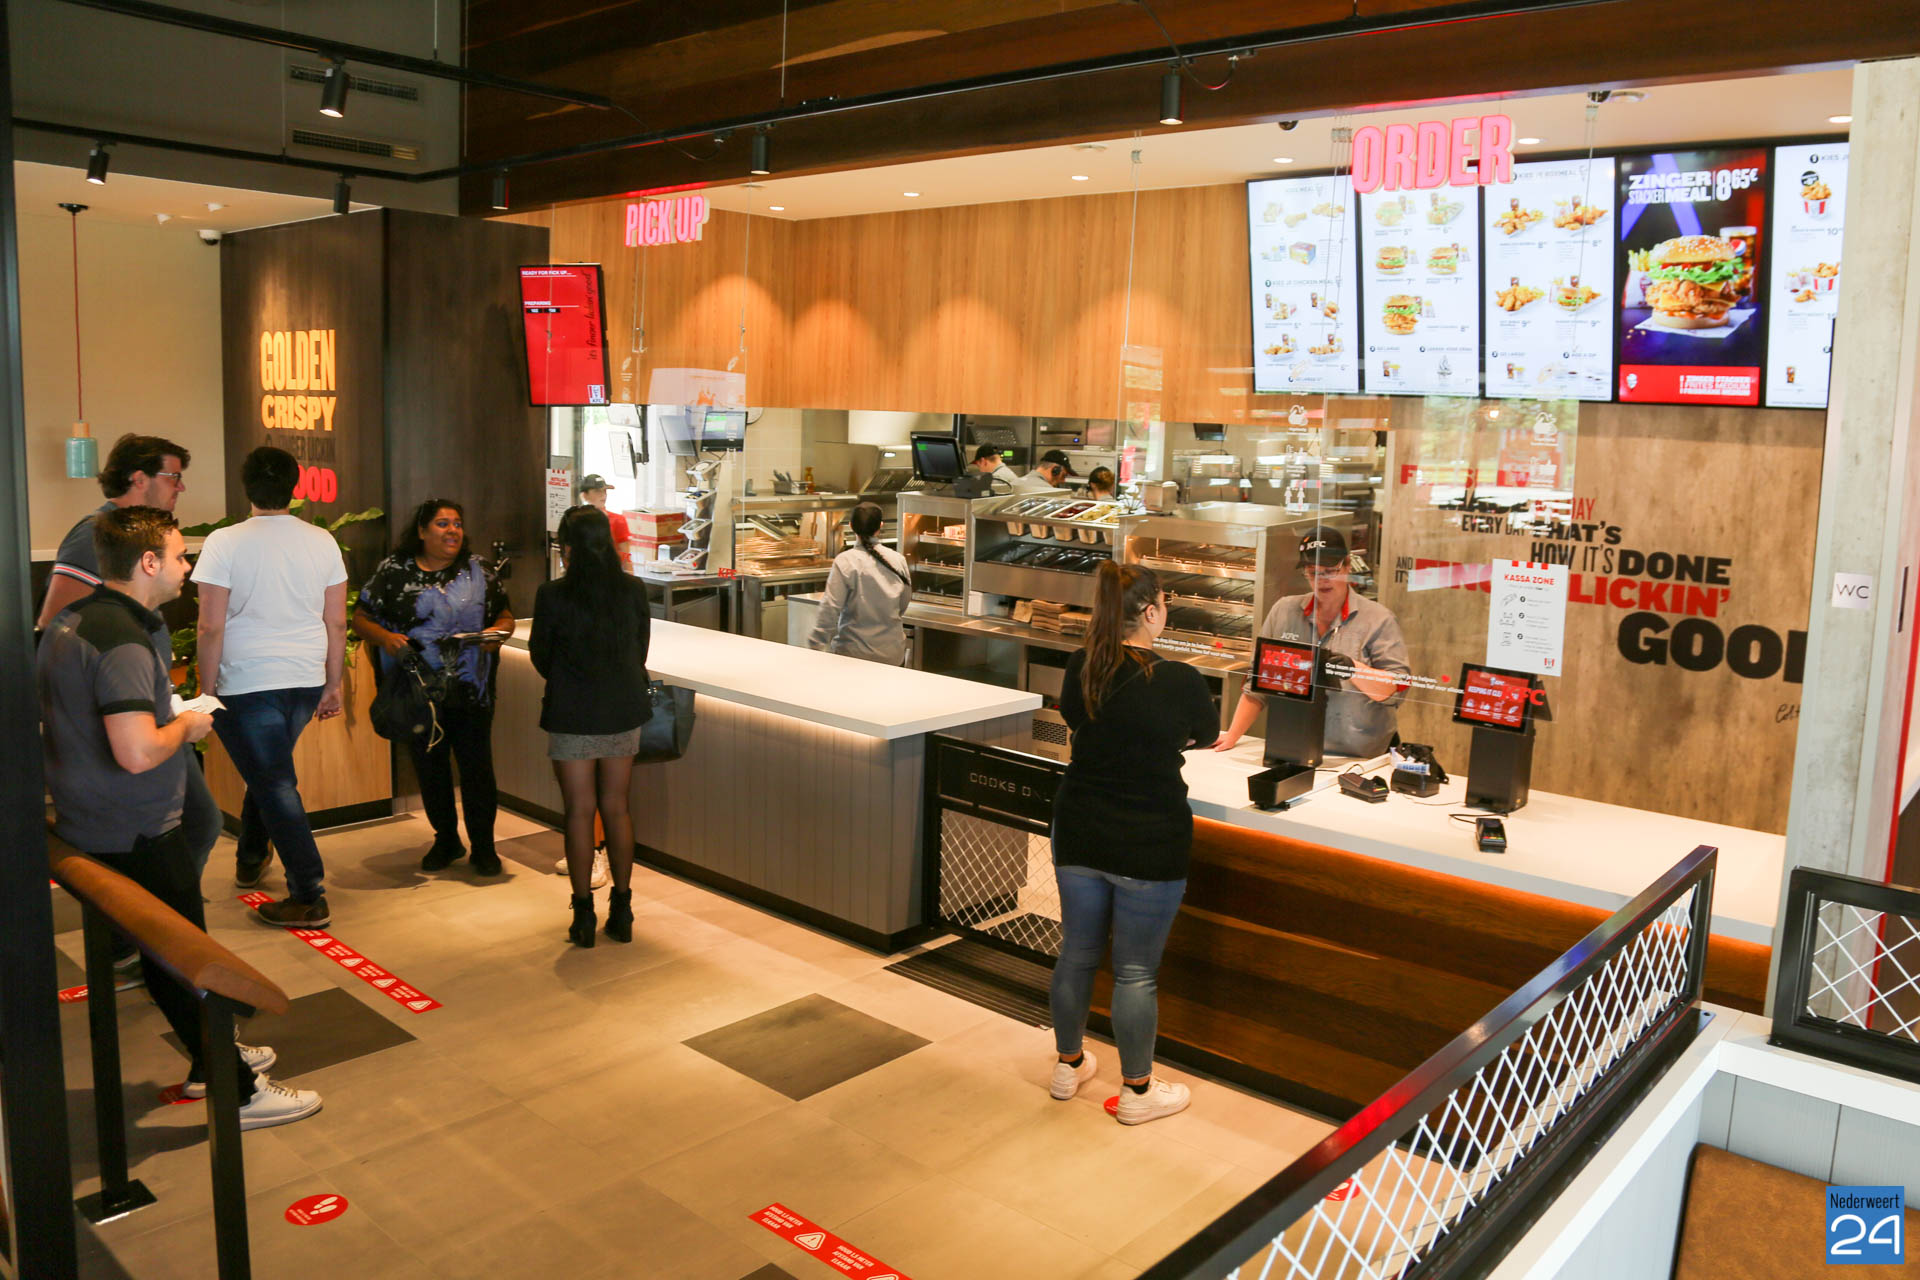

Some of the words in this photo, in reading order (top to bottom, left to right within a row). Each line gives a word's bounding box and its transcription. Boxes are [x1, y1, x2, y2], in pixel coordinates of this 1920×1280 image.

[1352, 114, 1514, 193] ORDER
[1628, 170, 1712, 190] ZINGER
[1628, 188, 1665, 205] STACKER
[1665, 186, 1712, 203] MEAL
[624, 200, 673, 247] PICK
[675, 194, 706, 242] UP
[260, 329, 336, 391] GOLDEN
[261, 394, 337, 431] CRISPY
[293, 465, 338, 503] OOD
[1462, 514, 1503, 534] EVERY
[1306, 540, 1327, 550] KFC
[1396, 556, 1413, 571] AND
[1530, 542, 1576, 570] HOW
[1583, 544, 1614, 574] IT'S
[1618, 549, 1732, 585] DONE
[717, 568, 737, 580] KFC
[1504, 574, 1530, 583] KASSA
[1532, 577, 1555, 585] ZONE
[1568, 573, 1730, 618] LICKIN'
[1836, 584, 1869, 599] WC
[1281, 632, 1299, 640] KFC
[1263, 650, 1301, 669] KFC
[969, 772, 1016, 793] COOKS
